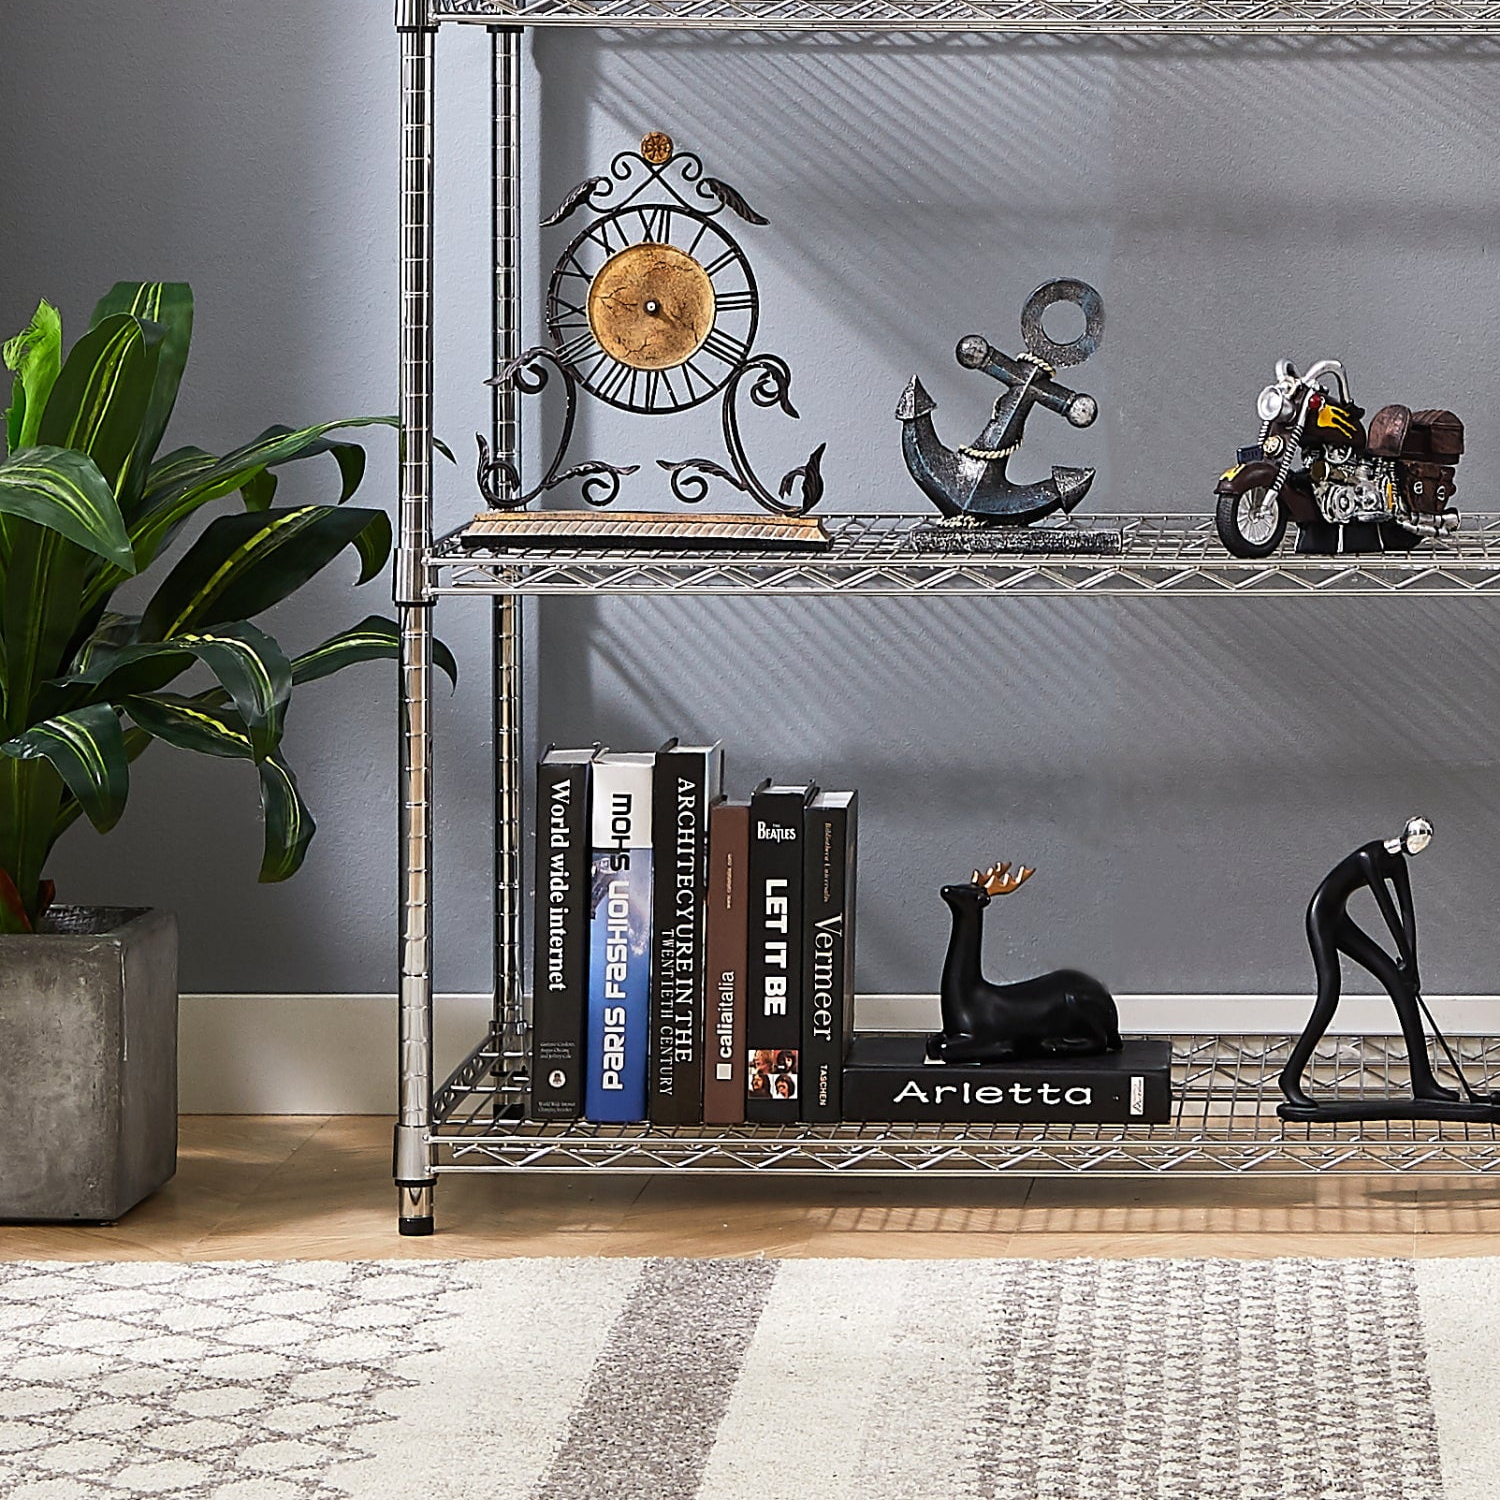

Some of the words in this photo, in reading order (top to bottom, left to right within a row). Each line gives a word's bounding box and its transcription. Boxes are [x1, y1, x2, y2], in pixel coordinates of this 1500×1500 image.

[550, 778, 571, 848] World
[549, 853, 570, 903] wide
[675, 777, 696, 972] ARCHITECYURE
[765, 879, 788, 934] LET
[548, 907, 569, 991] internet
[660, 928, 675, 1018] TWENTIETH
[765, 942, 787, 968] IT
[676, 978, 694, 1005] IN
[764, 977, 786, 1016] BE
[813, 912, 843, 1042] Vermeer
[674, 1010, 693, 1063] THE
[717, 971, 736, 1059] caliaitalia
[659, 1025, 673, 1096] CENTURY
[819, 1064, 828, 1106] TASCHEN
[893, 1080, 1092, 1105] Arletta
